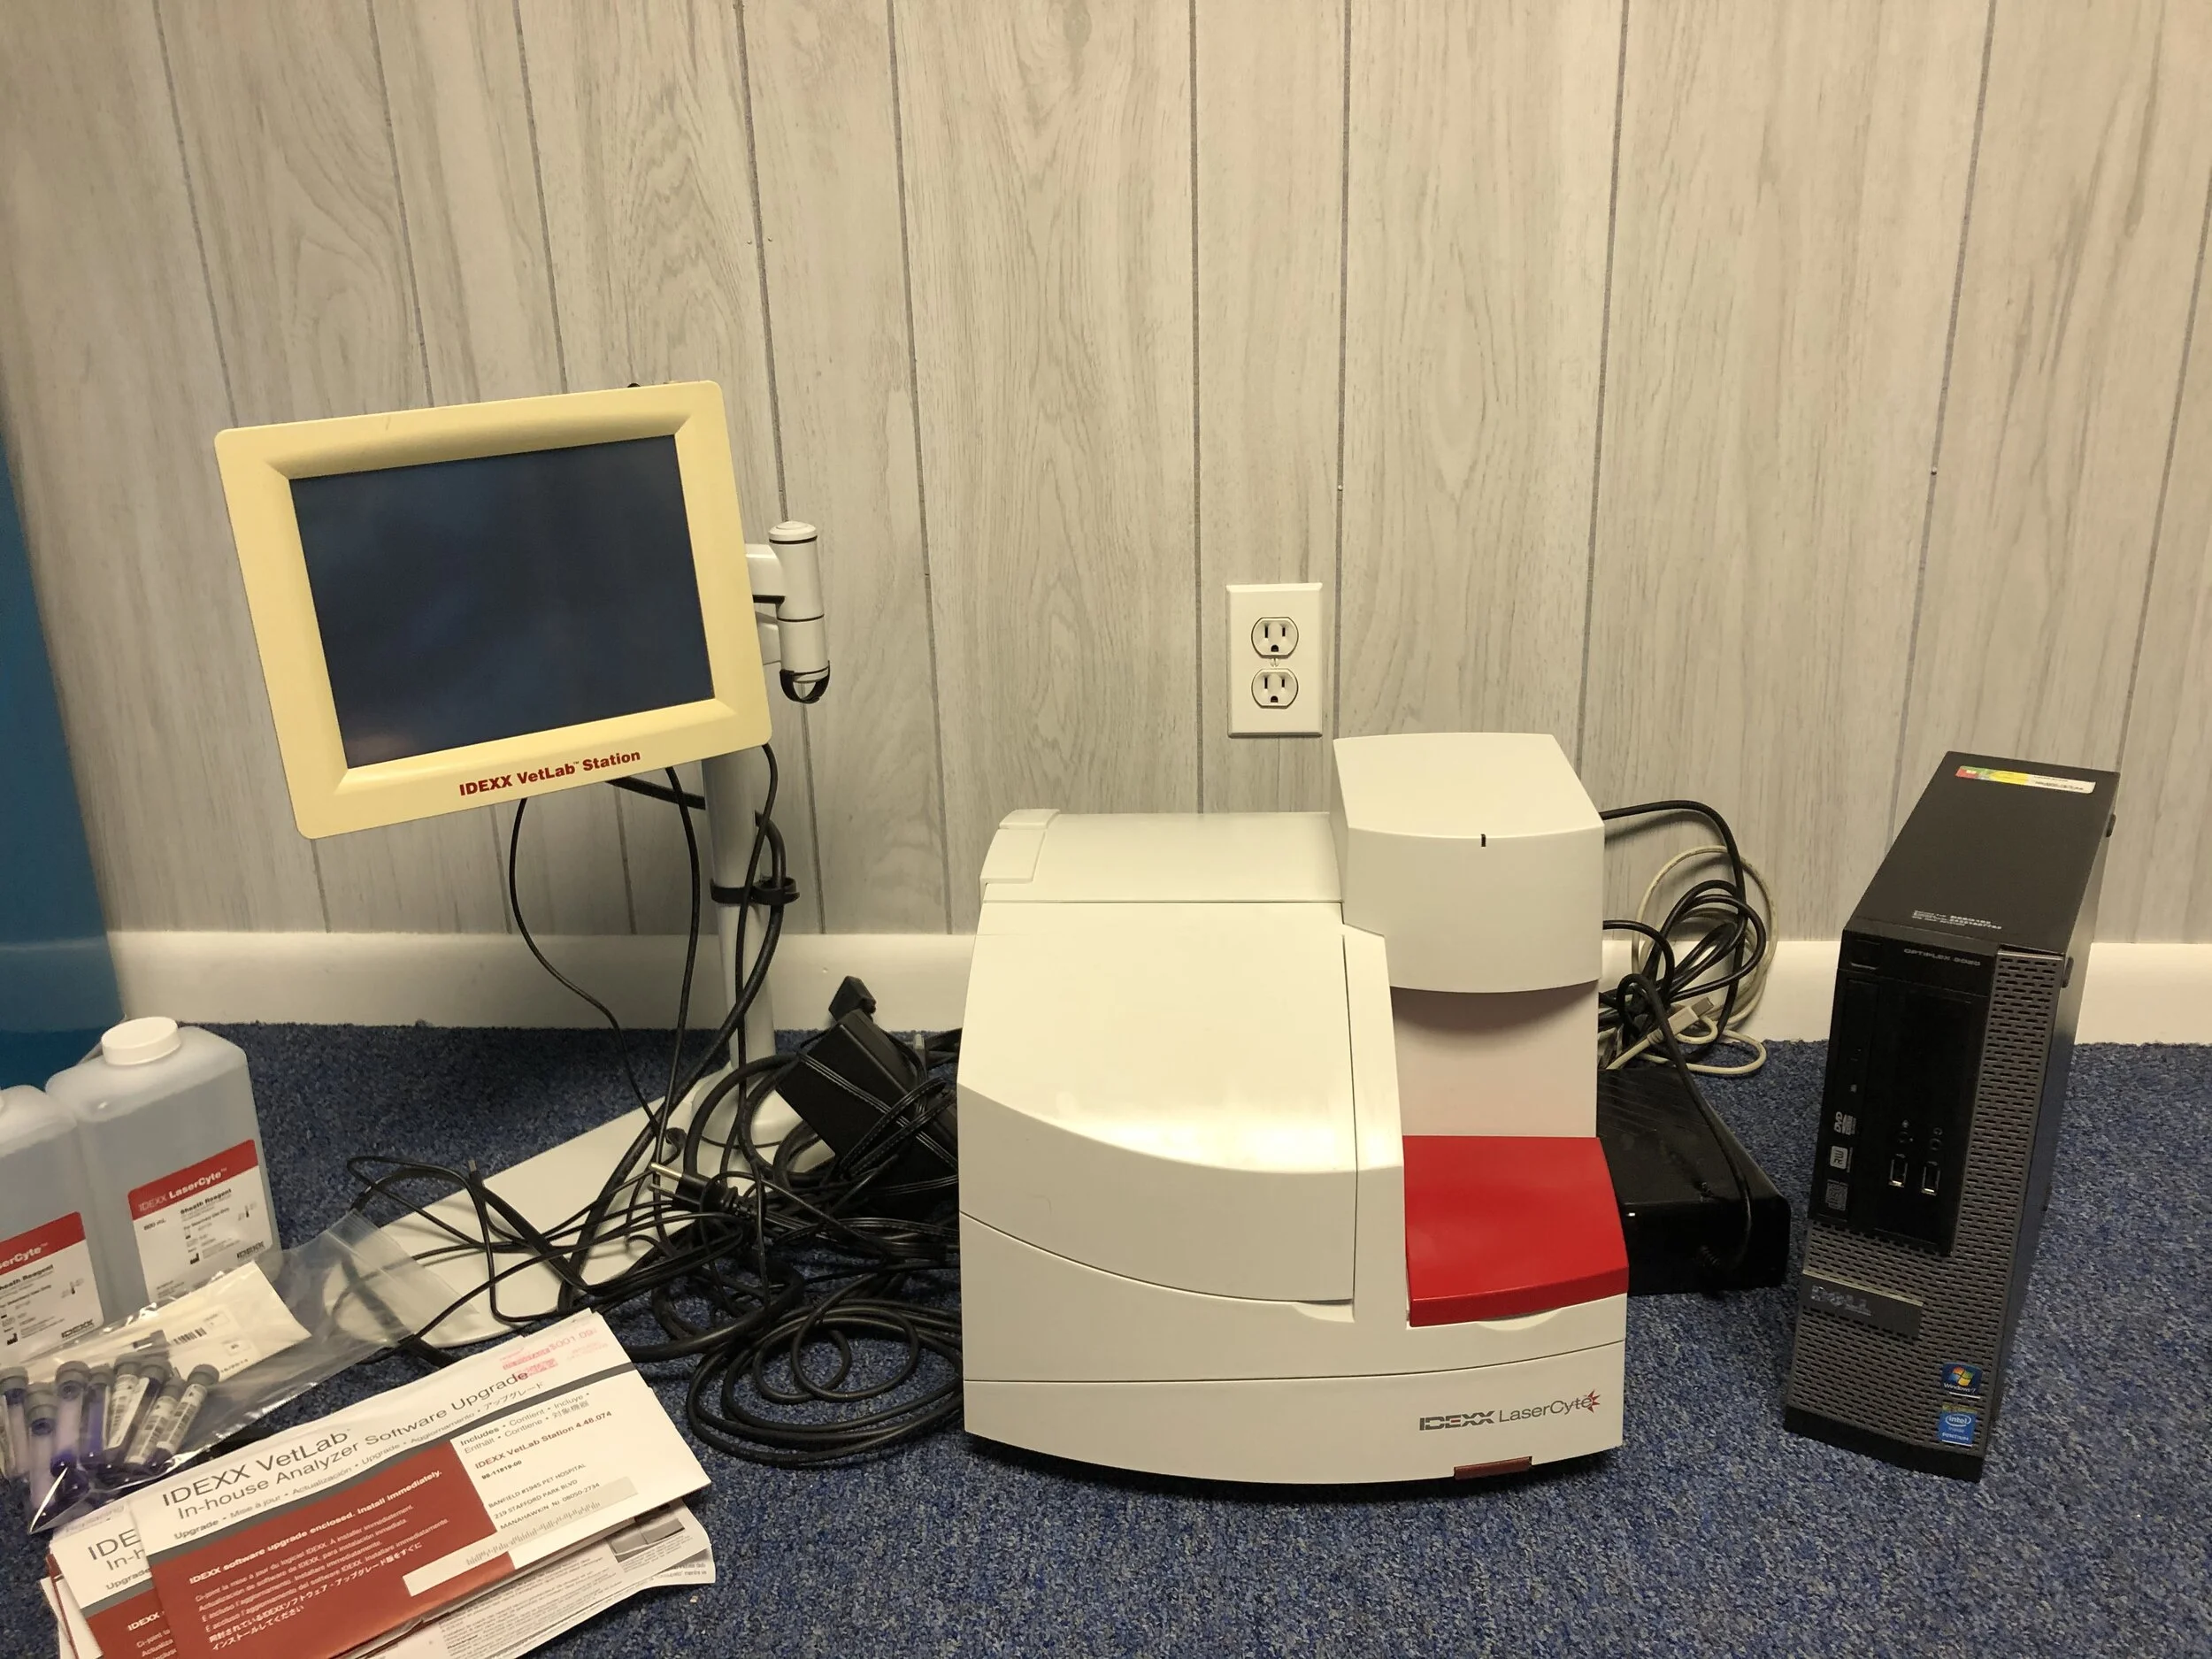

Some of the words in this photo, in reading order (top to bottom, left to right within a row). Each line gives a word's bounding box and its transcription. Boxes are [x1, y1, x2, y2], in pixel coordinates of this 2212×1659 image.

[459, 775, 513, 796] IDEXX
[582, 751, 641, 772] Station
[139, 1194, 167, 1212] IDEXX
[180, 1202, 204, 1215] Sheath
[204, 1188, 232, 1204] Reagent
[236, 1240, 265, 1259] IDEXX
[22, 1263, 54, 1280] Reagent
[1943, 1382, 1970, 1393] Windows
[460, 1427, 500, 1446] Includes
[509, 1409, 545, 1426] Contient
[554, 1394, 584, 1409] Incluye
[1419, 1410, 1495, 1431] IDEXX
[1499, 1395, 1594, 1423] LaserCyte
[504, 1418, 542, 1438] Contiene
[177, 1479, 270, 1519] In-house
[276, 1441, 358, 1485] Analyzer
[365, 1409, 447, 1446] Software
[451, 1371, 528, 1411] Upgrade
[474, 1453, 506, 1470] IDEXX
[506, 1440, 541, 1456] VetLab
[541, 1425, 574, 1442] Station
[162, 1464, 251, 1507] IDEXX
[174, 1519, 219, 1540] Upgrade
[230, 1506, 252, 1518] Mise
[264, 1495, 280, 1508] jour
[292, 1467, 352, 1494] Actualización
[362, 1442, 401, 1465] Upgrade
[411, 1412, 475, 1444] Aggiornamento
[488, 1490, 521, 1509] BANFIELD
[541, 1476, 554, 1486] PET
[555, 1463, 586, 1479] HOSPITAL
[507, 1494, 542, 1514] STAFFORD
[542, 1487, 560, 1498] PARK
[560, 1479, 578, 1490] BLVD
[189, 1566, 221, 1585] IDEXX
[223, 1548, 265, 1571] software
[267, 1531, 308, 1552] upgrade
[310, 1511, 356, 1534] enclosed.
[357, 1497, 386, 1515] Install
[387, 1470, 442, 1502] immediately.
[500, 1504, 549, 1530] MANAHAWKIN
[106, 1567, 151, 1590] Upgrade
[257, 1571, 288, 1587] software
[311, 1569, 342, 1586] software
[128, 1611, 160, 1631] IDEXX
